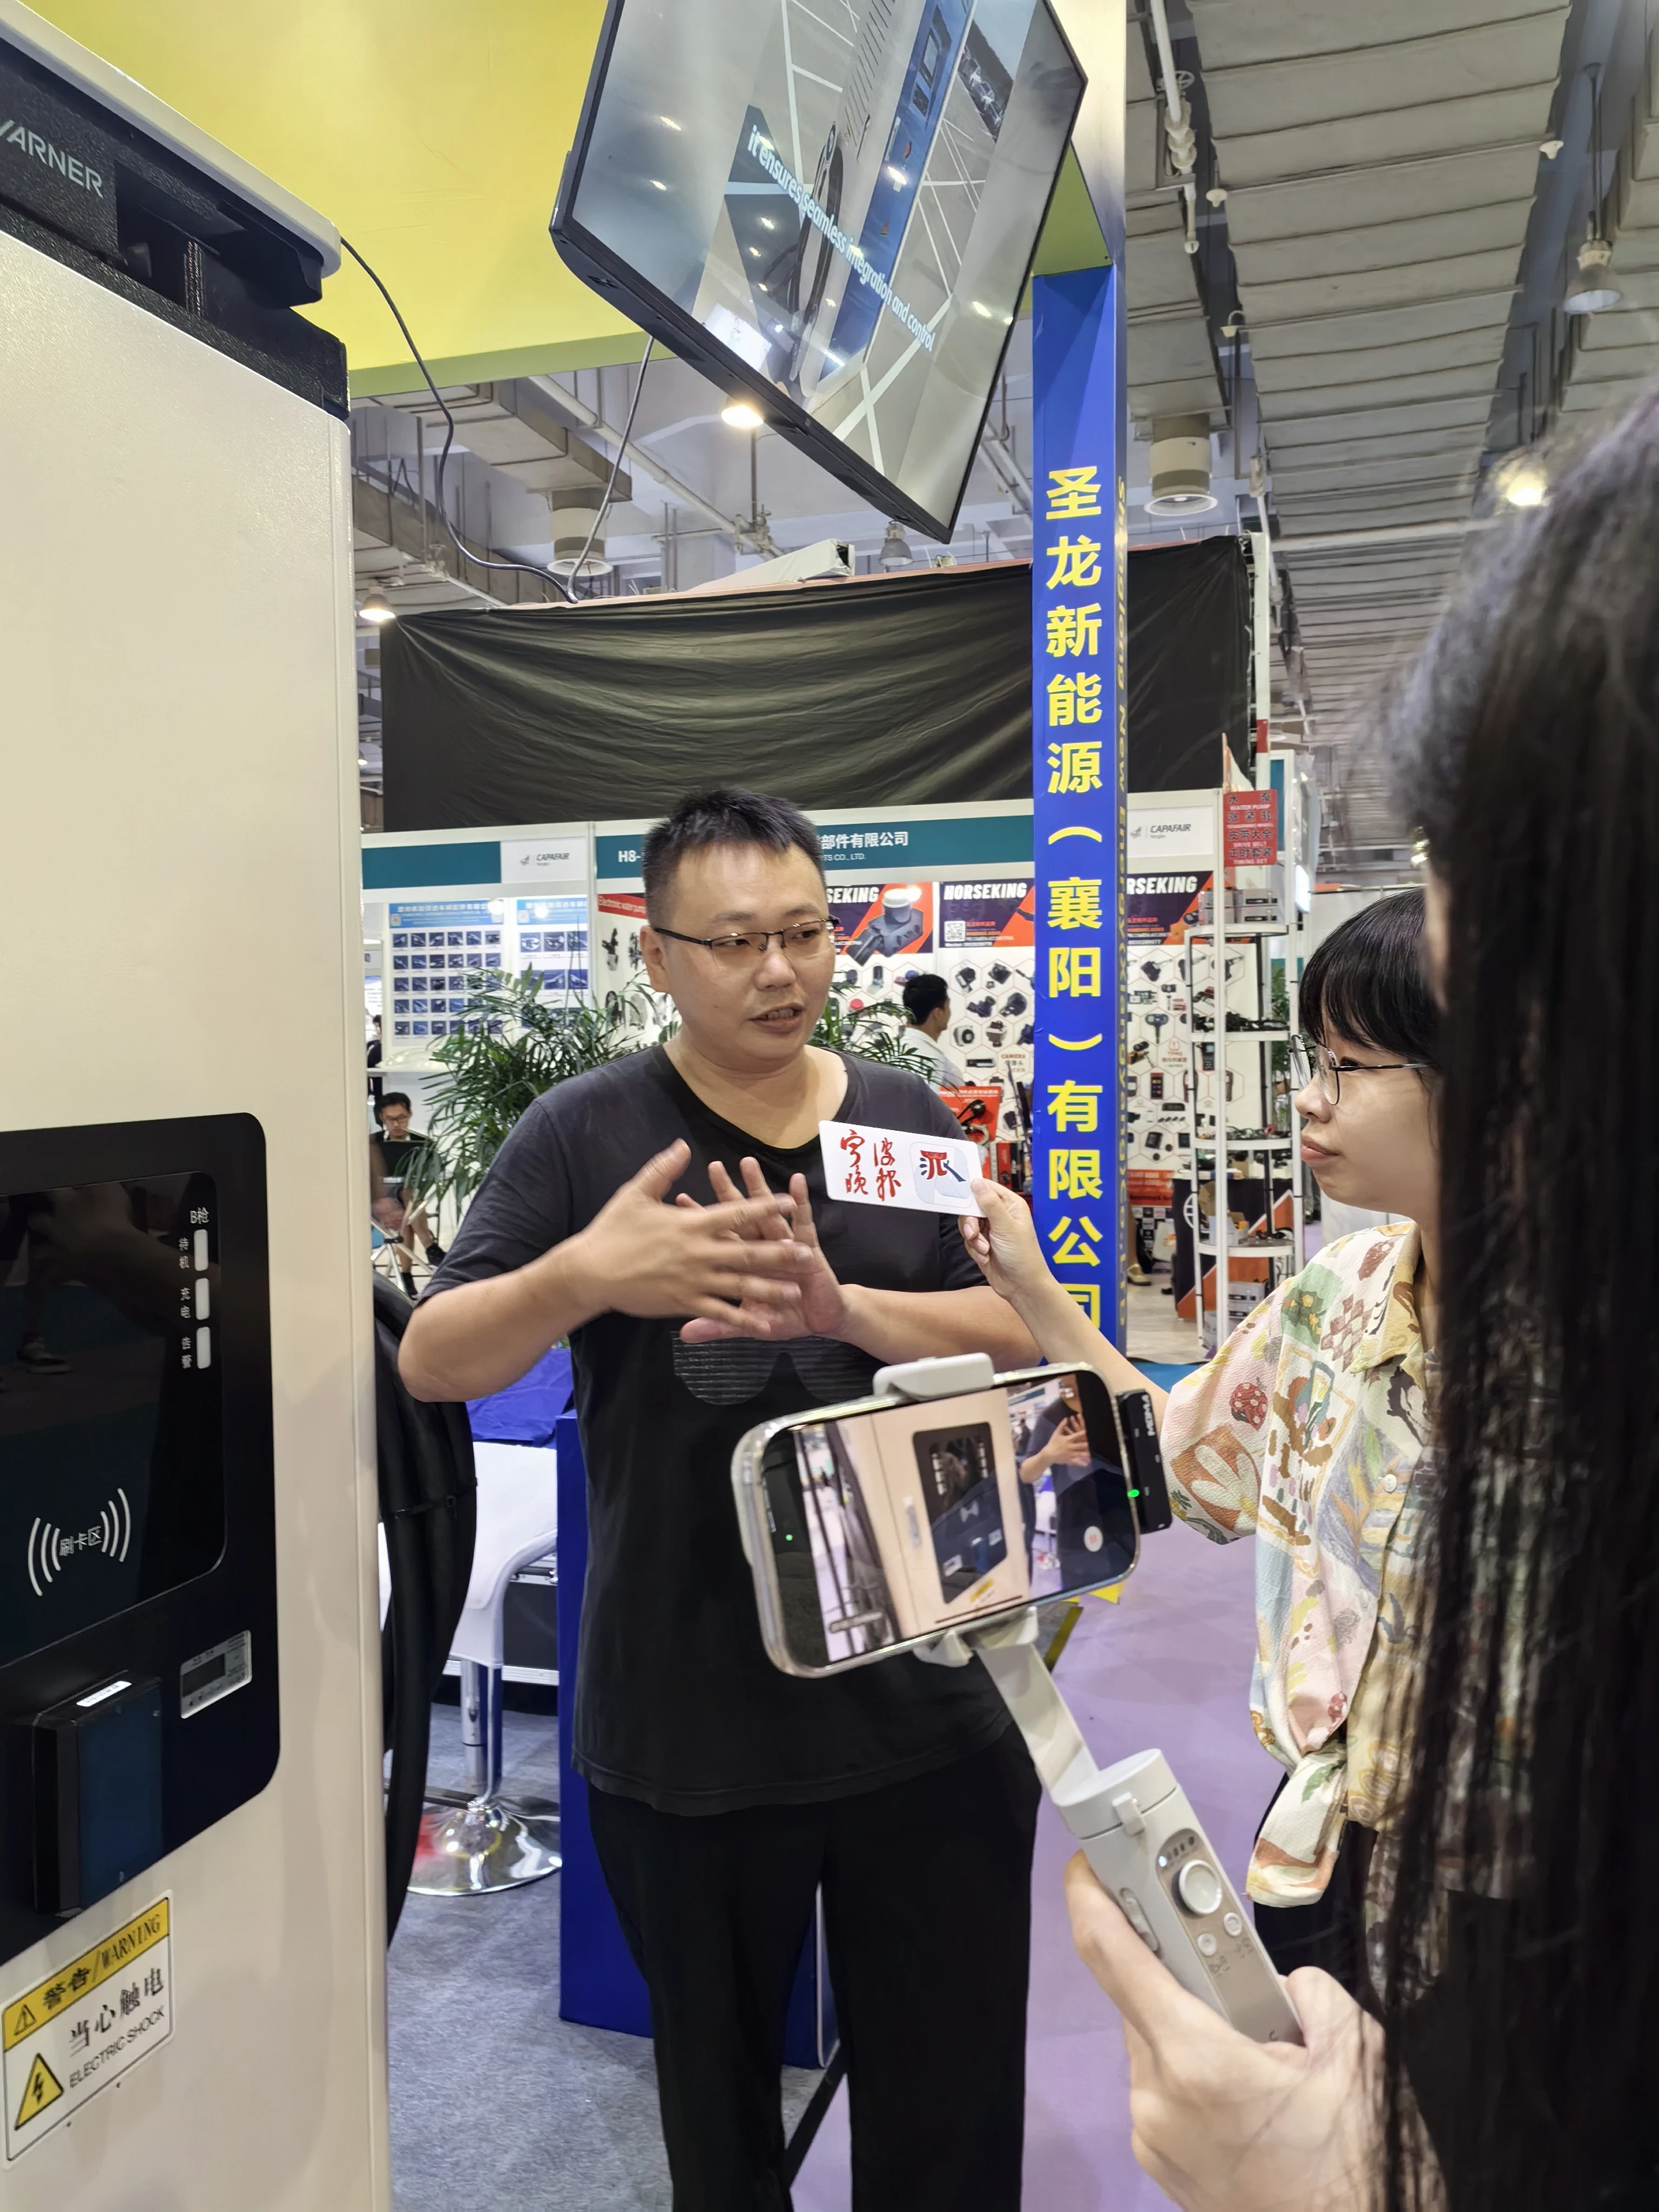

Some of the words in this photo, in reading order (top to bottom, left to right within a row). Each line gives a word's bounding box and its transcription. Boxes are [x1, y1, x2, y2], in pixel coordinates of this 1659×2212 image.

[759, 145, 803, 204] ensures
[802, 193, 847, 253] seamless
[846, 237, 893, 306] integration
[892, 295, 911, 323] and
[908, 314, 936, 352] control
[820, 831, 909, 849] 部件有限公司
[1150, 824, 1191, 833] CAPAFAIR
[944, 882, 1027, 900] HORSEKING
[59, 1525, 102, 1556] 刷卡区
[68, 1967, 164, 2058] 当心触电
[69, 2036, 126, 2088] ELECTRIC
